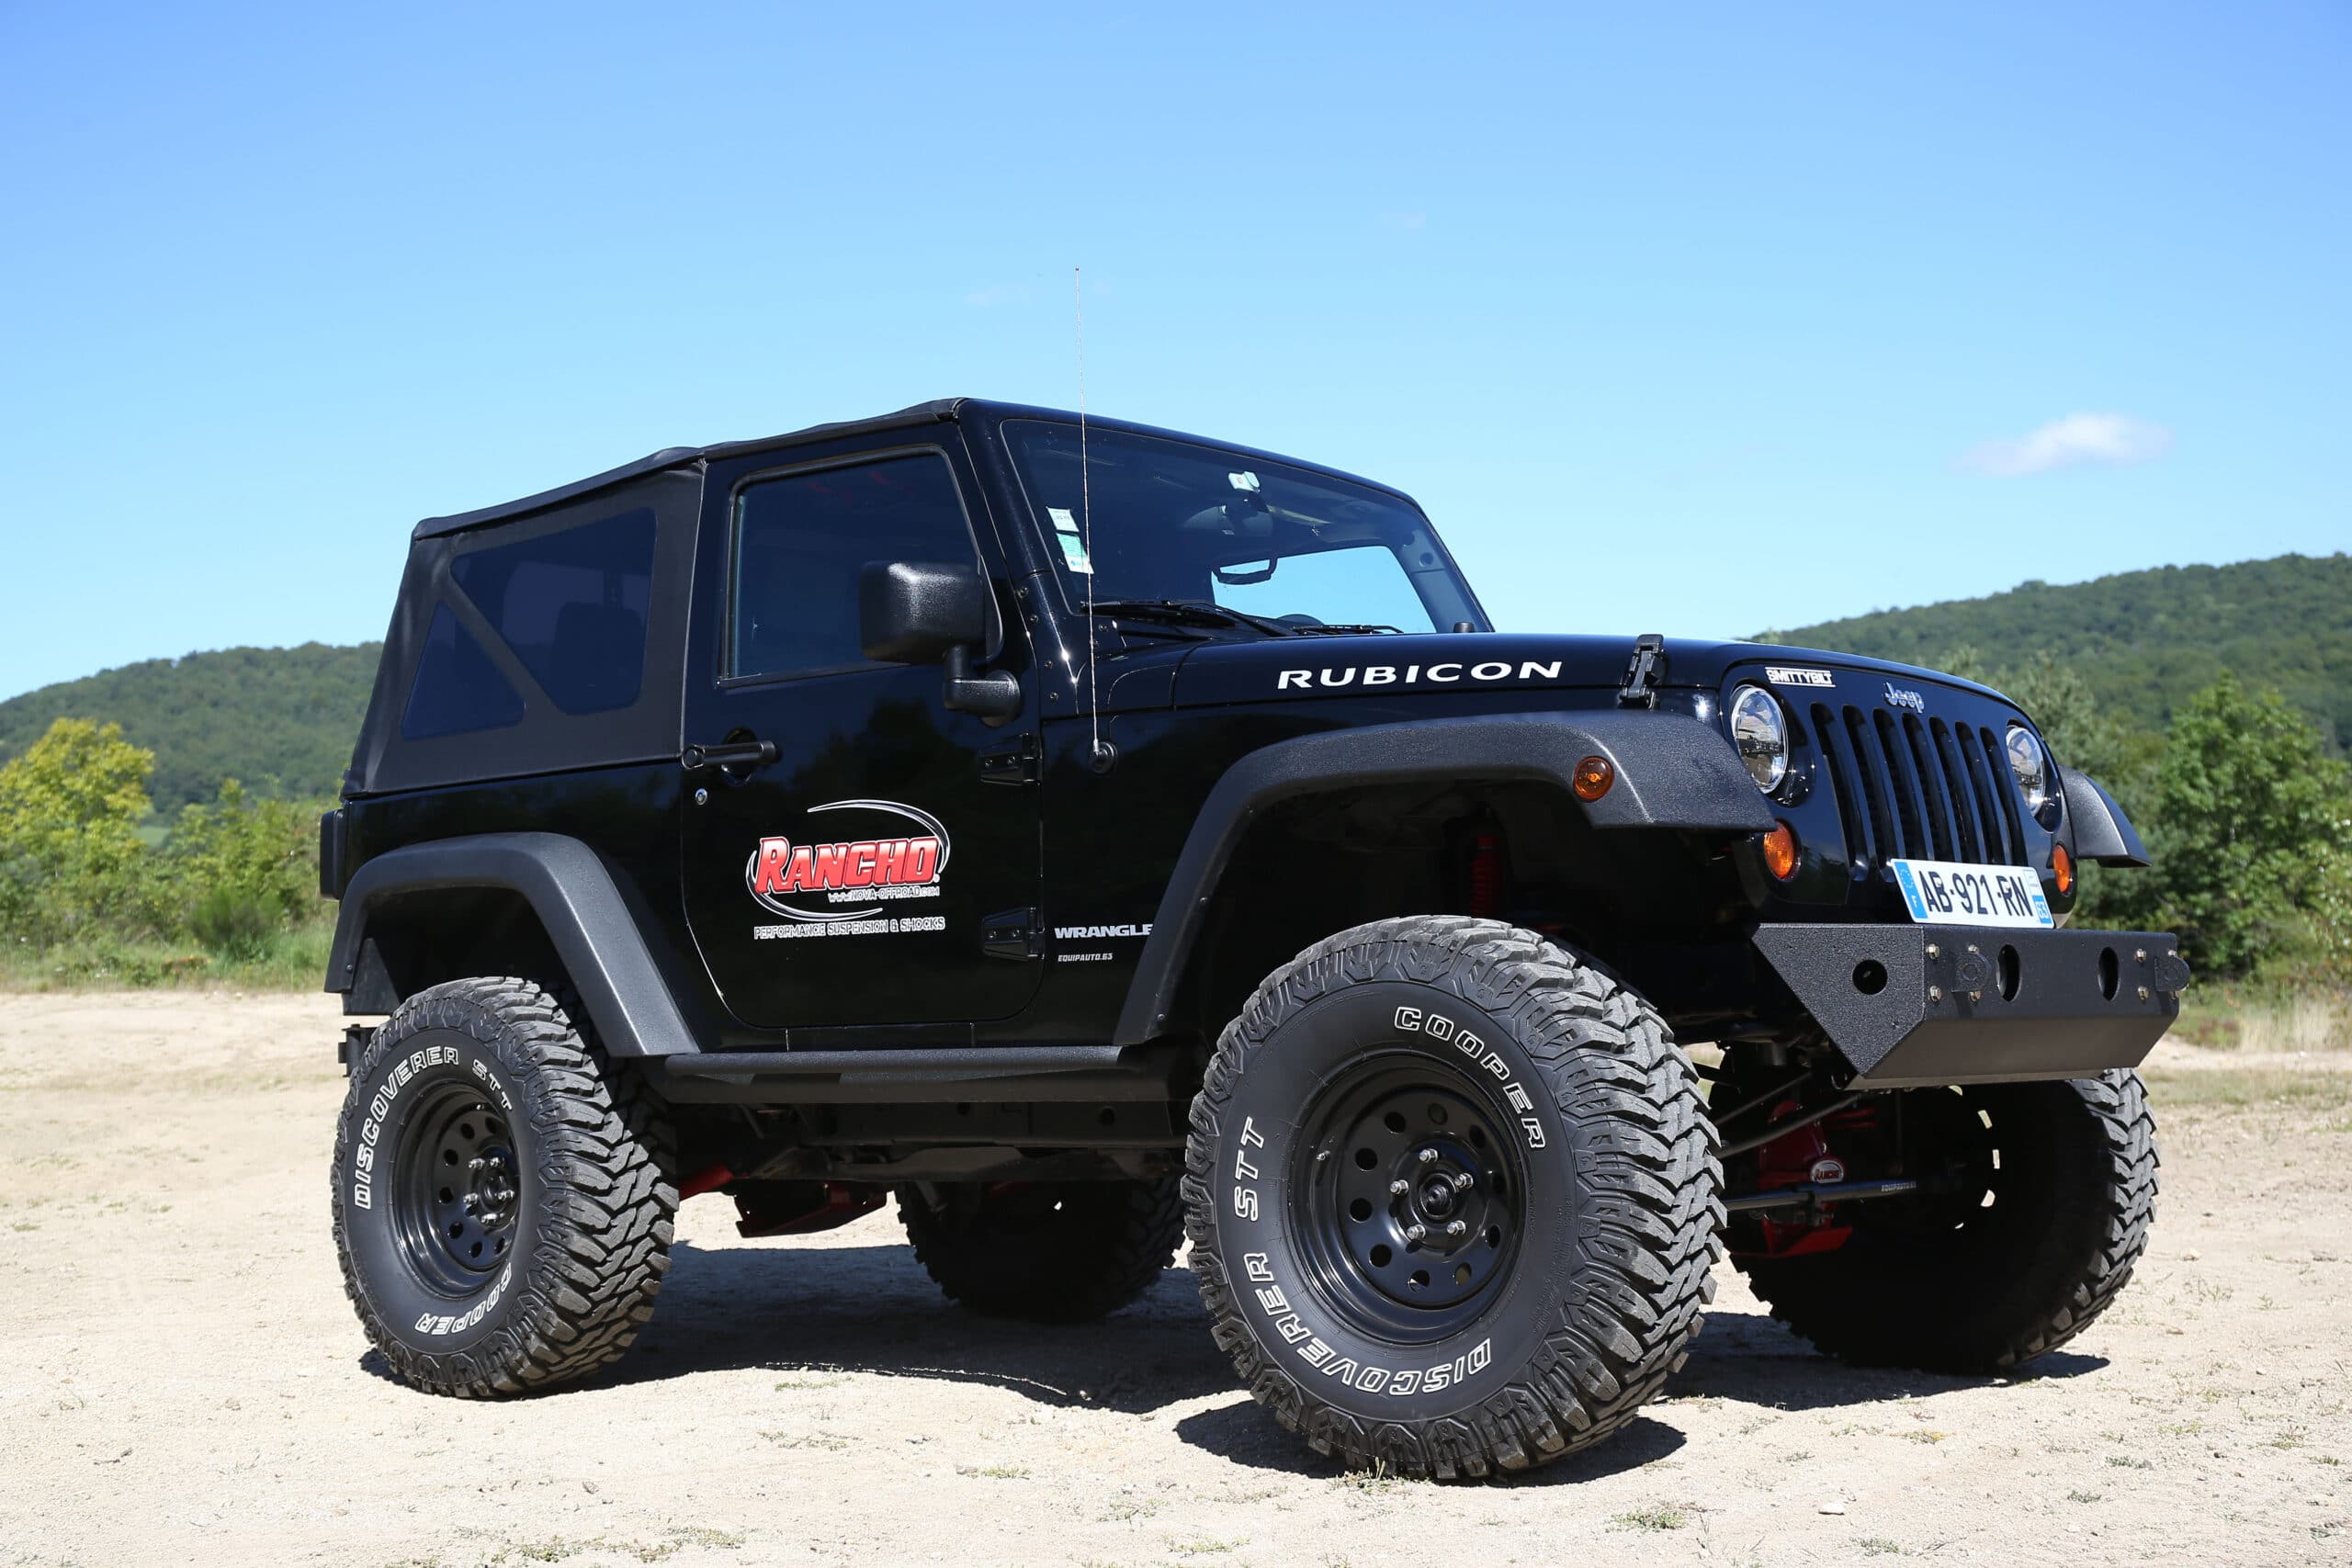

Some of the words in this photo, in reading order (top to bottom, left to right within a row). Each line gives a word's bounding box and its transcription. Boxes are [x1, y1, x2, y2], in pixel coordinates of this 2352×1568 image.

[1277, 661, 1562, 690] RUBICON
[1765, 668, 1833, 686] SMITTYBILT
[1883, 682, 1925, 714] Jeep
[754, 836, 939, 896] RANCHO
[753, 922, 826, 941] PERFORMANCE
[826, 919, 888, 936] SUSPENSION
[889, 919, 899, 933] &
[899, 916, 946, 932] SHOCKS
[1057, 953, 1114, 963] EQUIPAUTO.63
[1394, 1005, 1546, 1150] COOPER
[355, 1045, 459, 1211] DISCOVERER
[470, 1057, 514, 1111] STT
[1235, 1115, 1266, 1223] STT
[414, 1261, 514, 1337] COOPER
[1244, 1252, 1492, 1397] DISCOVERER
